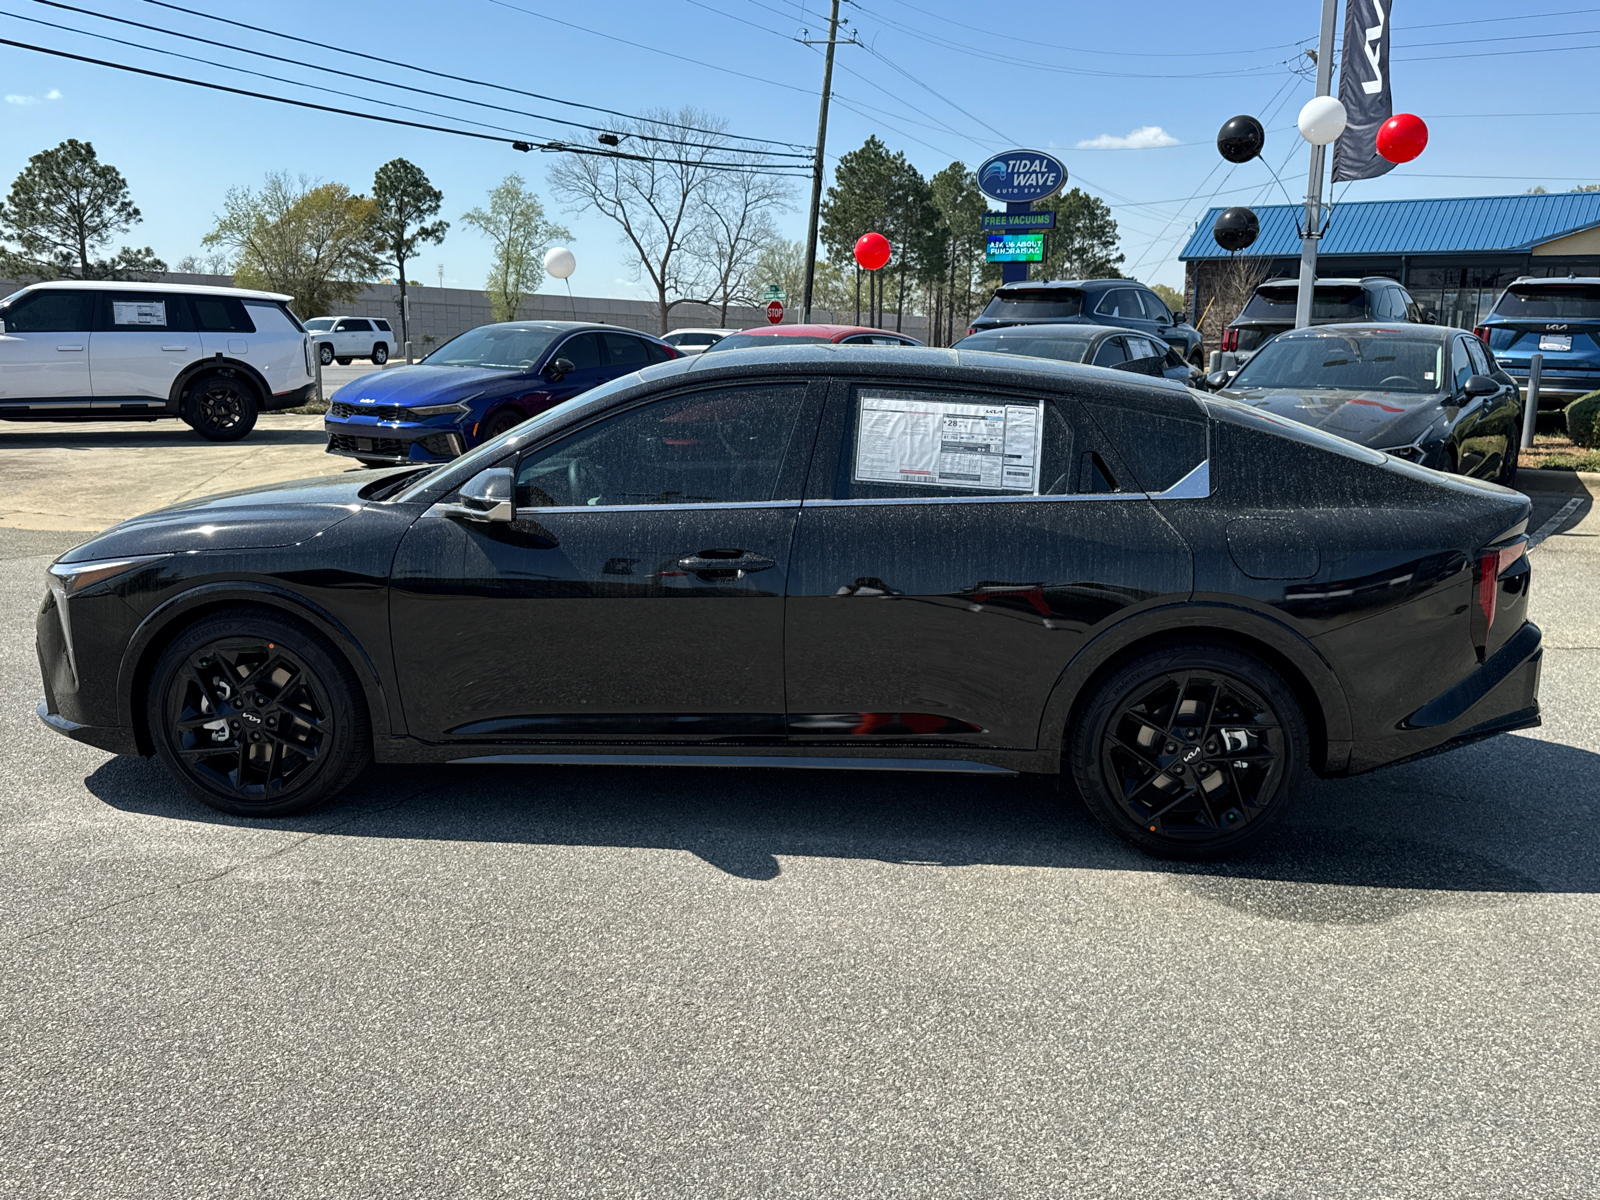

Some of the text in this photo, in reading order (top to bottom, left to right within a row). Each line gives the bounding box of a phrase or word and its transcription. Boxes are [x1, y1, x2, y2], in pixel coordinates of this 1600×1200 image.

[1007, 160, 1048, 173] TIDAL
[1013, 173, 1057, 186] WAVE
[984, 214, 1050, 226] FREE VACUUMS
[767, 308, 783, 318] STOP
[947, 419, 958, 427] 28
